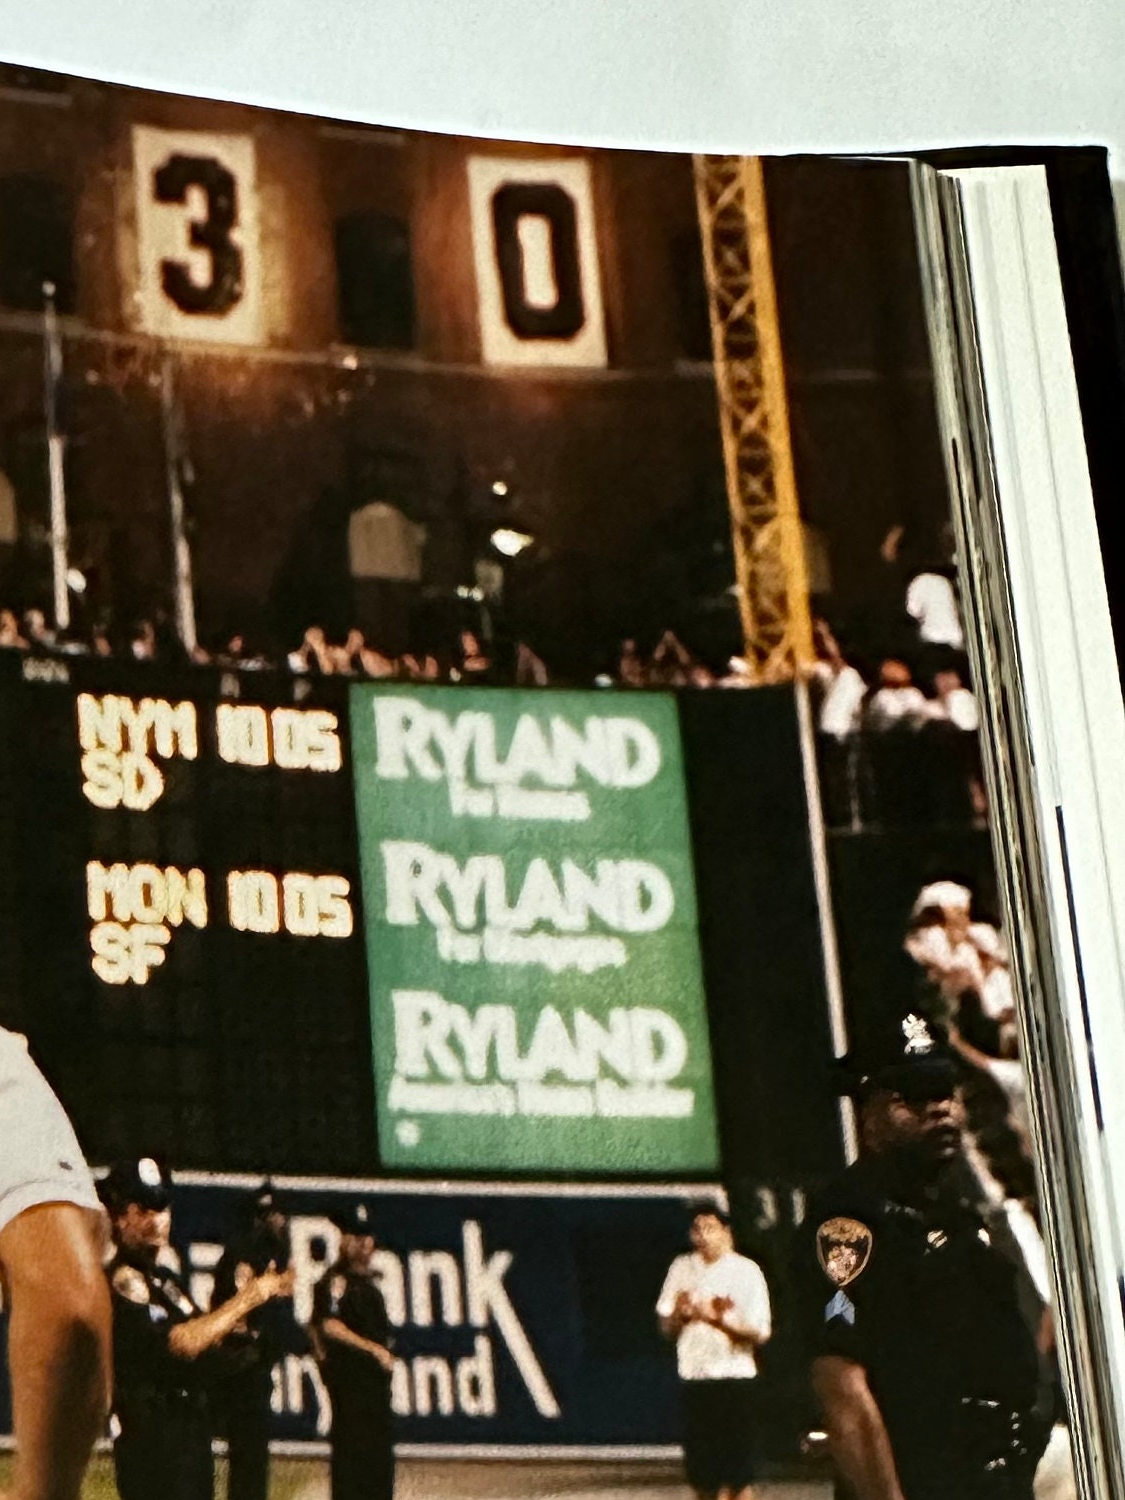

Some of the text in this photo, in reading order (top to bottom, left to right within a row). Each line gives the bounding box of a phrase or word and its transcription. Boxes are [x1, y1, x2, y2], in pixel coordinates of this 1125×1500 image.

[77, 692, 197, 760] NYM
[373, 696, 662, 789] RYLAND
[80, 751, 166, 812] SD
[86, 860, 208, 929] MON
[379, 839, 675, 933] RYLAND
[89, 921, 172, 985] SF
[391, 989, 688, 1082] RYLAND
